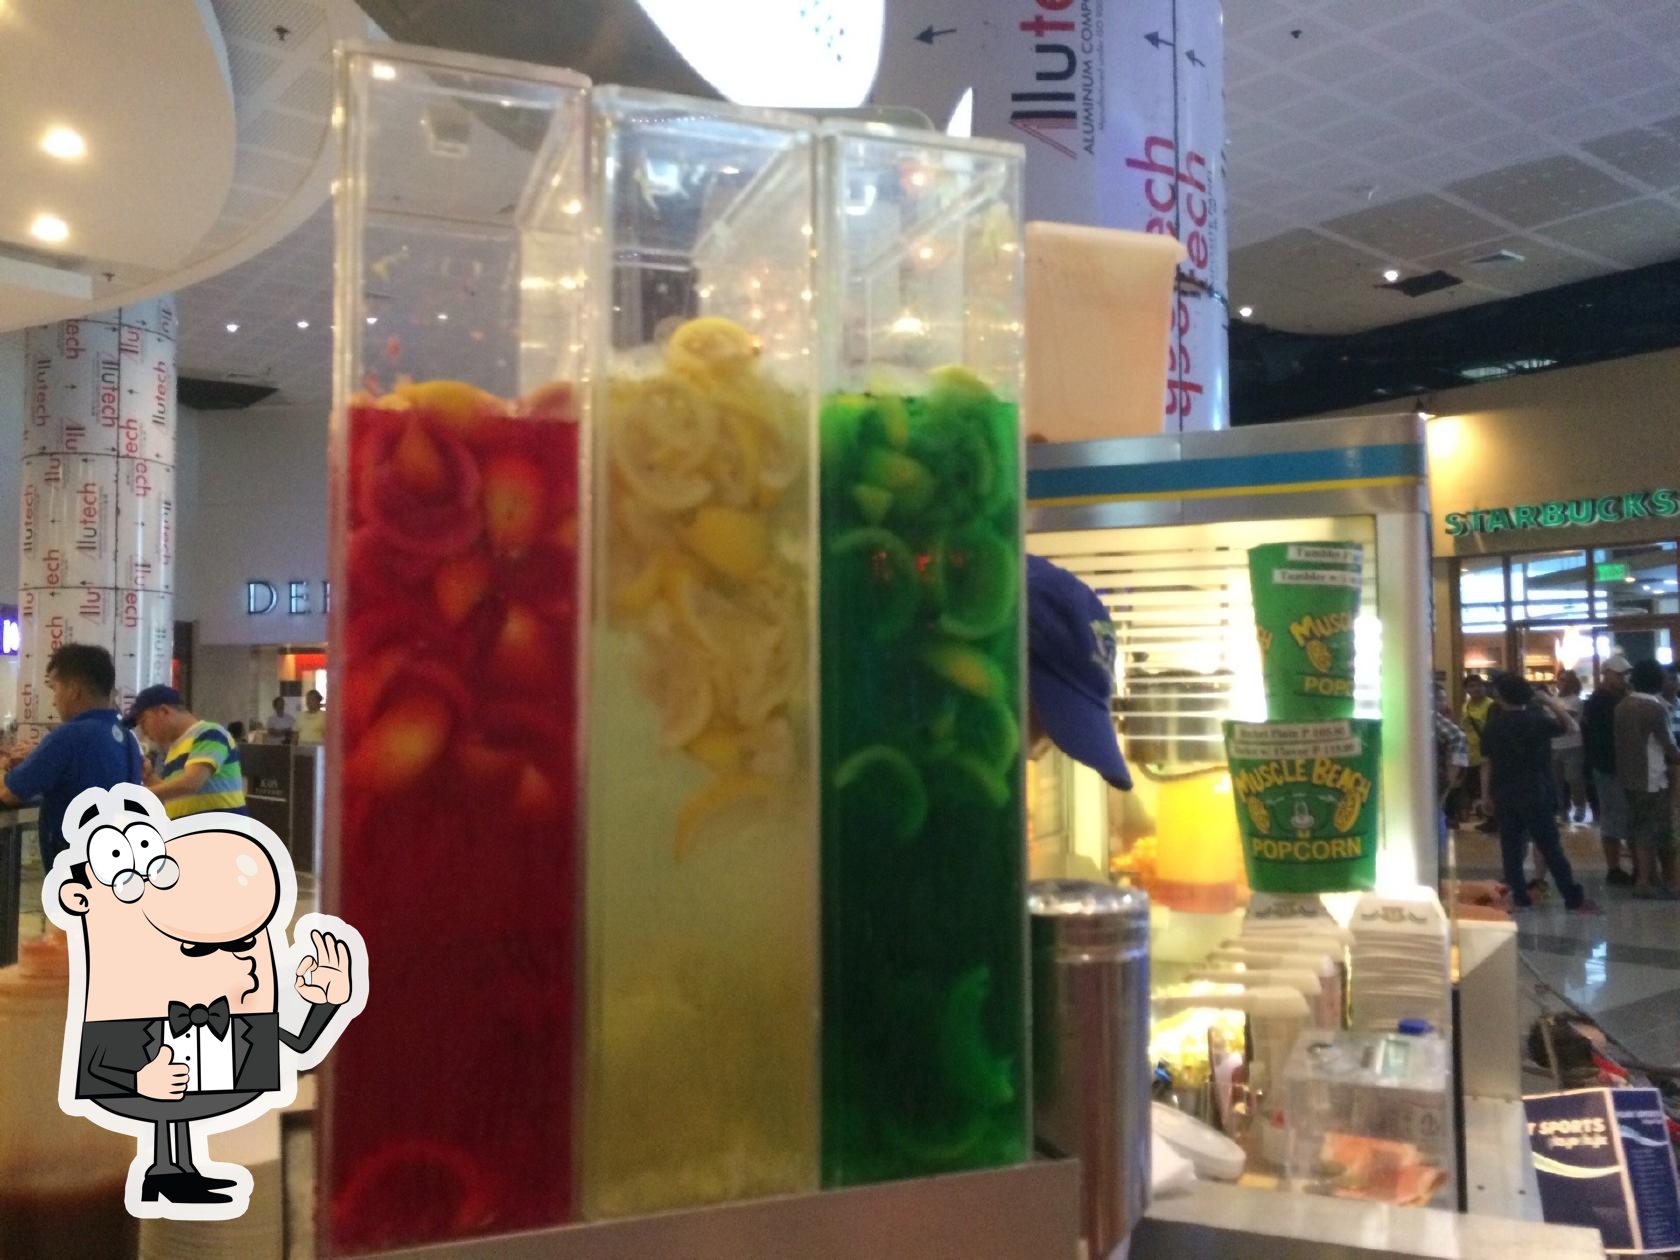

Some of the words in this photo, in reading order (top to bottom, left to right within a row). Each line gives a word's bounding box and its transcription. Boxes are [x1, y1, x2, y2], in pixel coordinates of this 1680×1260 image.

[1081, 0, 1093, 54] COMP
[1081, 59, 1095, 156] ALUMINUM
[1445, 489, 1680, 536] STARBUCKS
[1235, 757, 1308, 802] MUSCLE
[1313, 757, 1371, 803] BEACH
[1251, 837, 1362, 861] POPCORN
